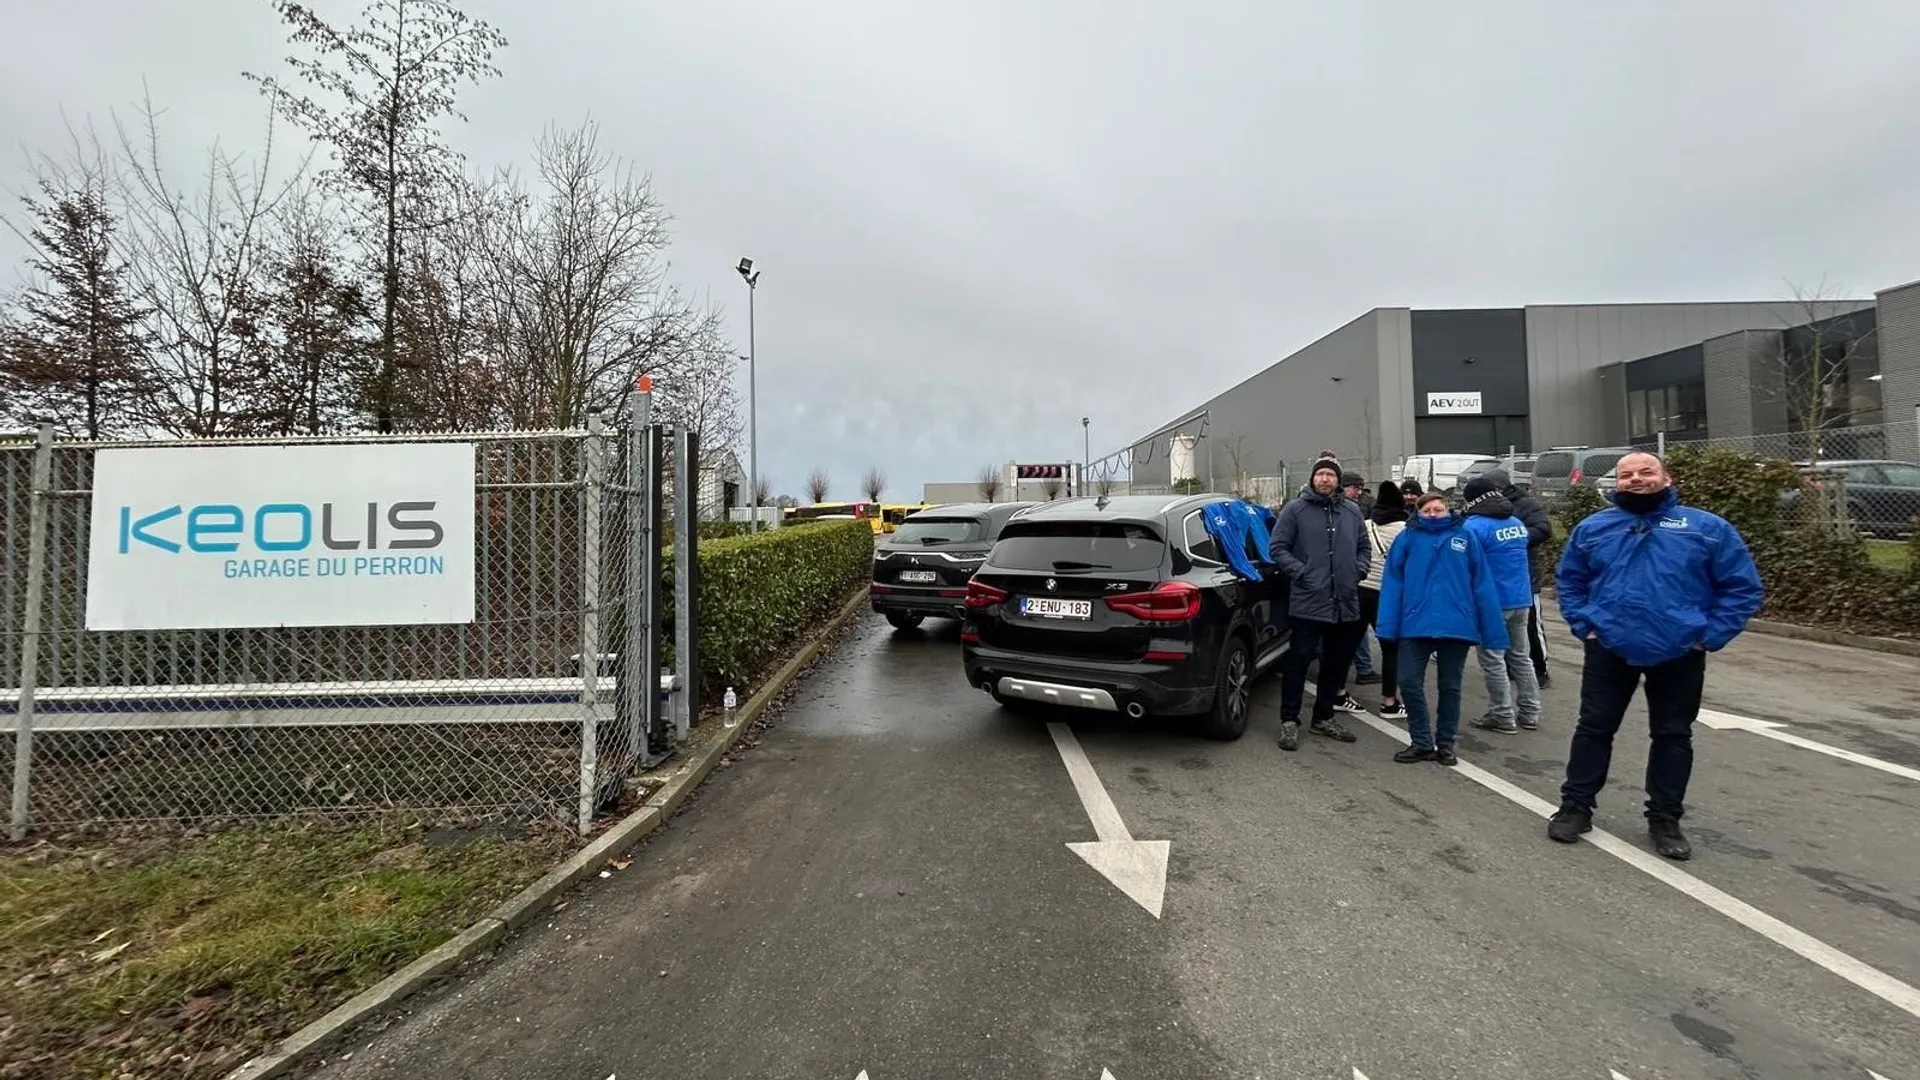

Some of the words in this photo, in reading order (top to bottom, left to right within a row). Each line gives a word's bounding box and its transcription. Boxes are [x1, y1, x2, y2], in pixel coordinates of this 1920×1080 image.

[1430, 398, 1455, 408] AEV
[224, 558, 309, 579] GARAGE
[317, 557, 346, 577] DU
[355, 556, 444, 576] PERRON
